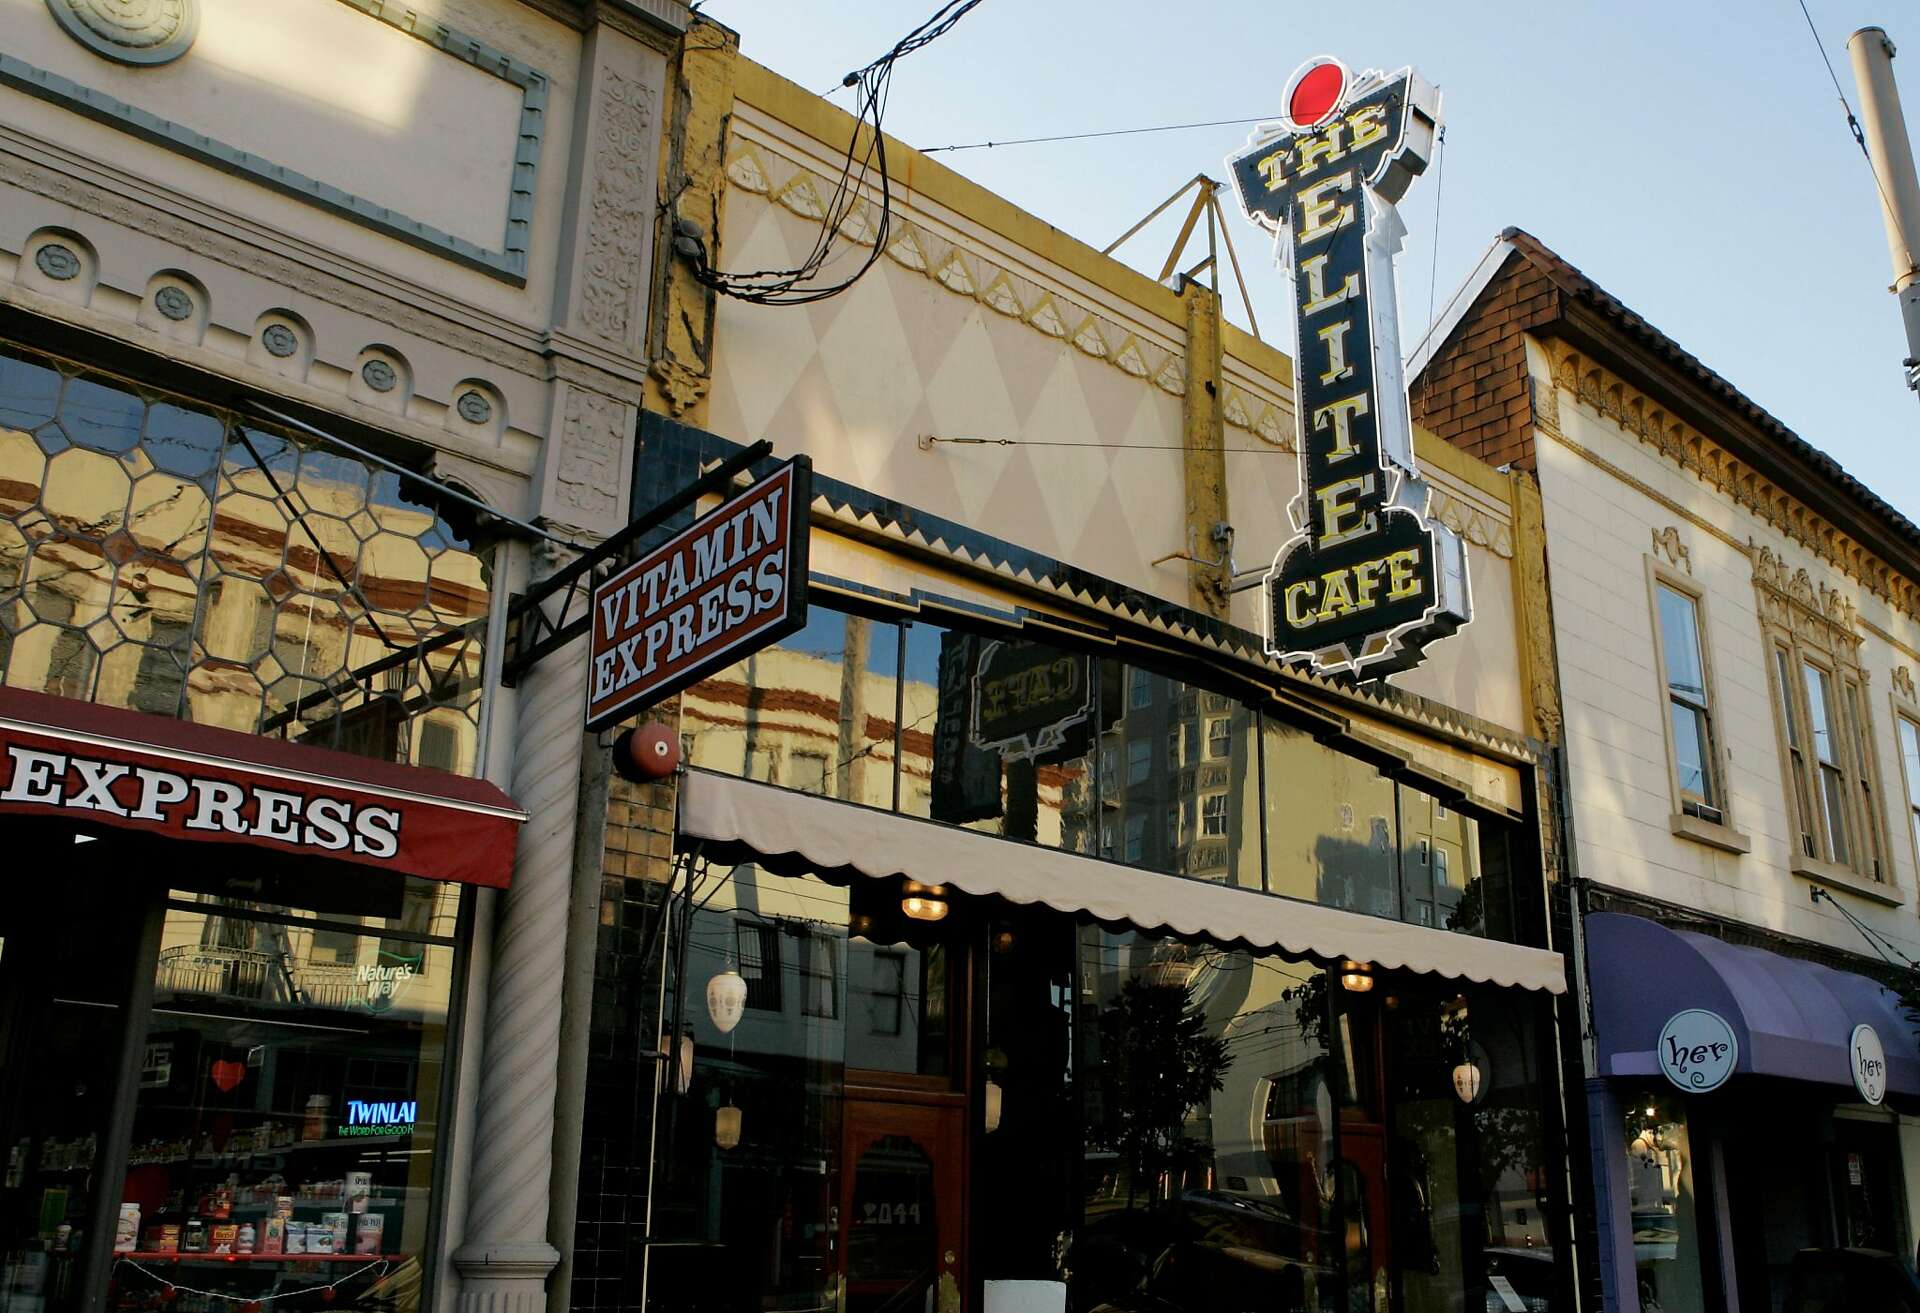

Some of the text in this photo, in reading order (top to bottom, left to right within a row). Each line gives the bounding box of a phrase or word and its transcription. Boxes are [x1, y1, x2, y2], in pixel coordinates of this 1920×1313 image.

[1257, 104, 1388, 192] THE
[1298, 171, 1378, 549] ELITE
[600, 486, 783, 641] VITAMIN
[1284, 548, 1423, 628] CAFE
[591, 547, 784, 704] EXPRESS
[1, 746, 401, 859] EXPRESS
[357, 963, 412, 982] Nature's
[367, 979, 401, 999] Way
[1666, 1034, 1729, 1074] her
[1857, 1046, 1883, 1084] her
